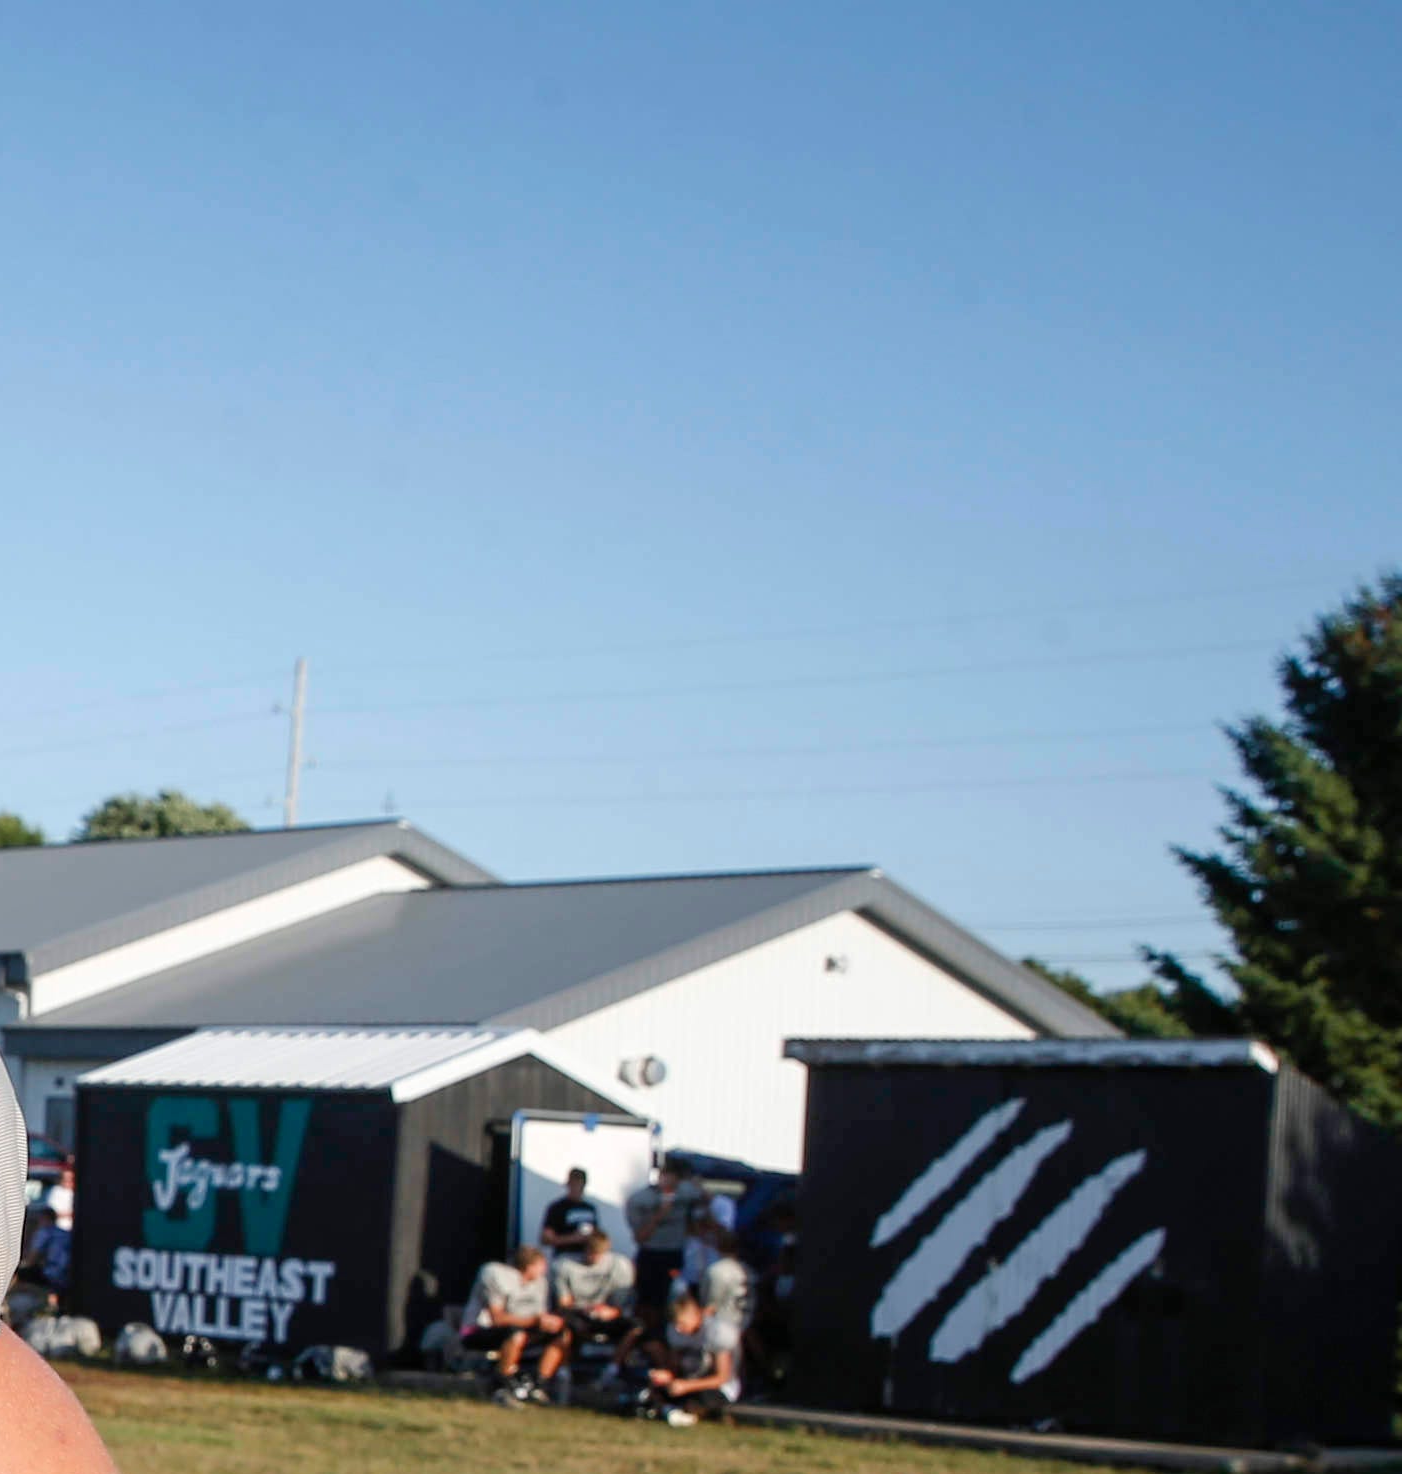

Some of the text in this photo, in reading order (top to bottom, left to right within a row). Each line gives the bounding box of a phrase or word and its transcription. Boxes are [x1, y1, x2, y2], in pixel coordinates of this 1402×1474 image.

[143, 1097, 314, 1254] SV
[153, 1143, 281, 1209] Jaguars
[113, 1248, 335, 1303] SOUTHEAST
[152, 1293, 295, 1343] VALLEY
